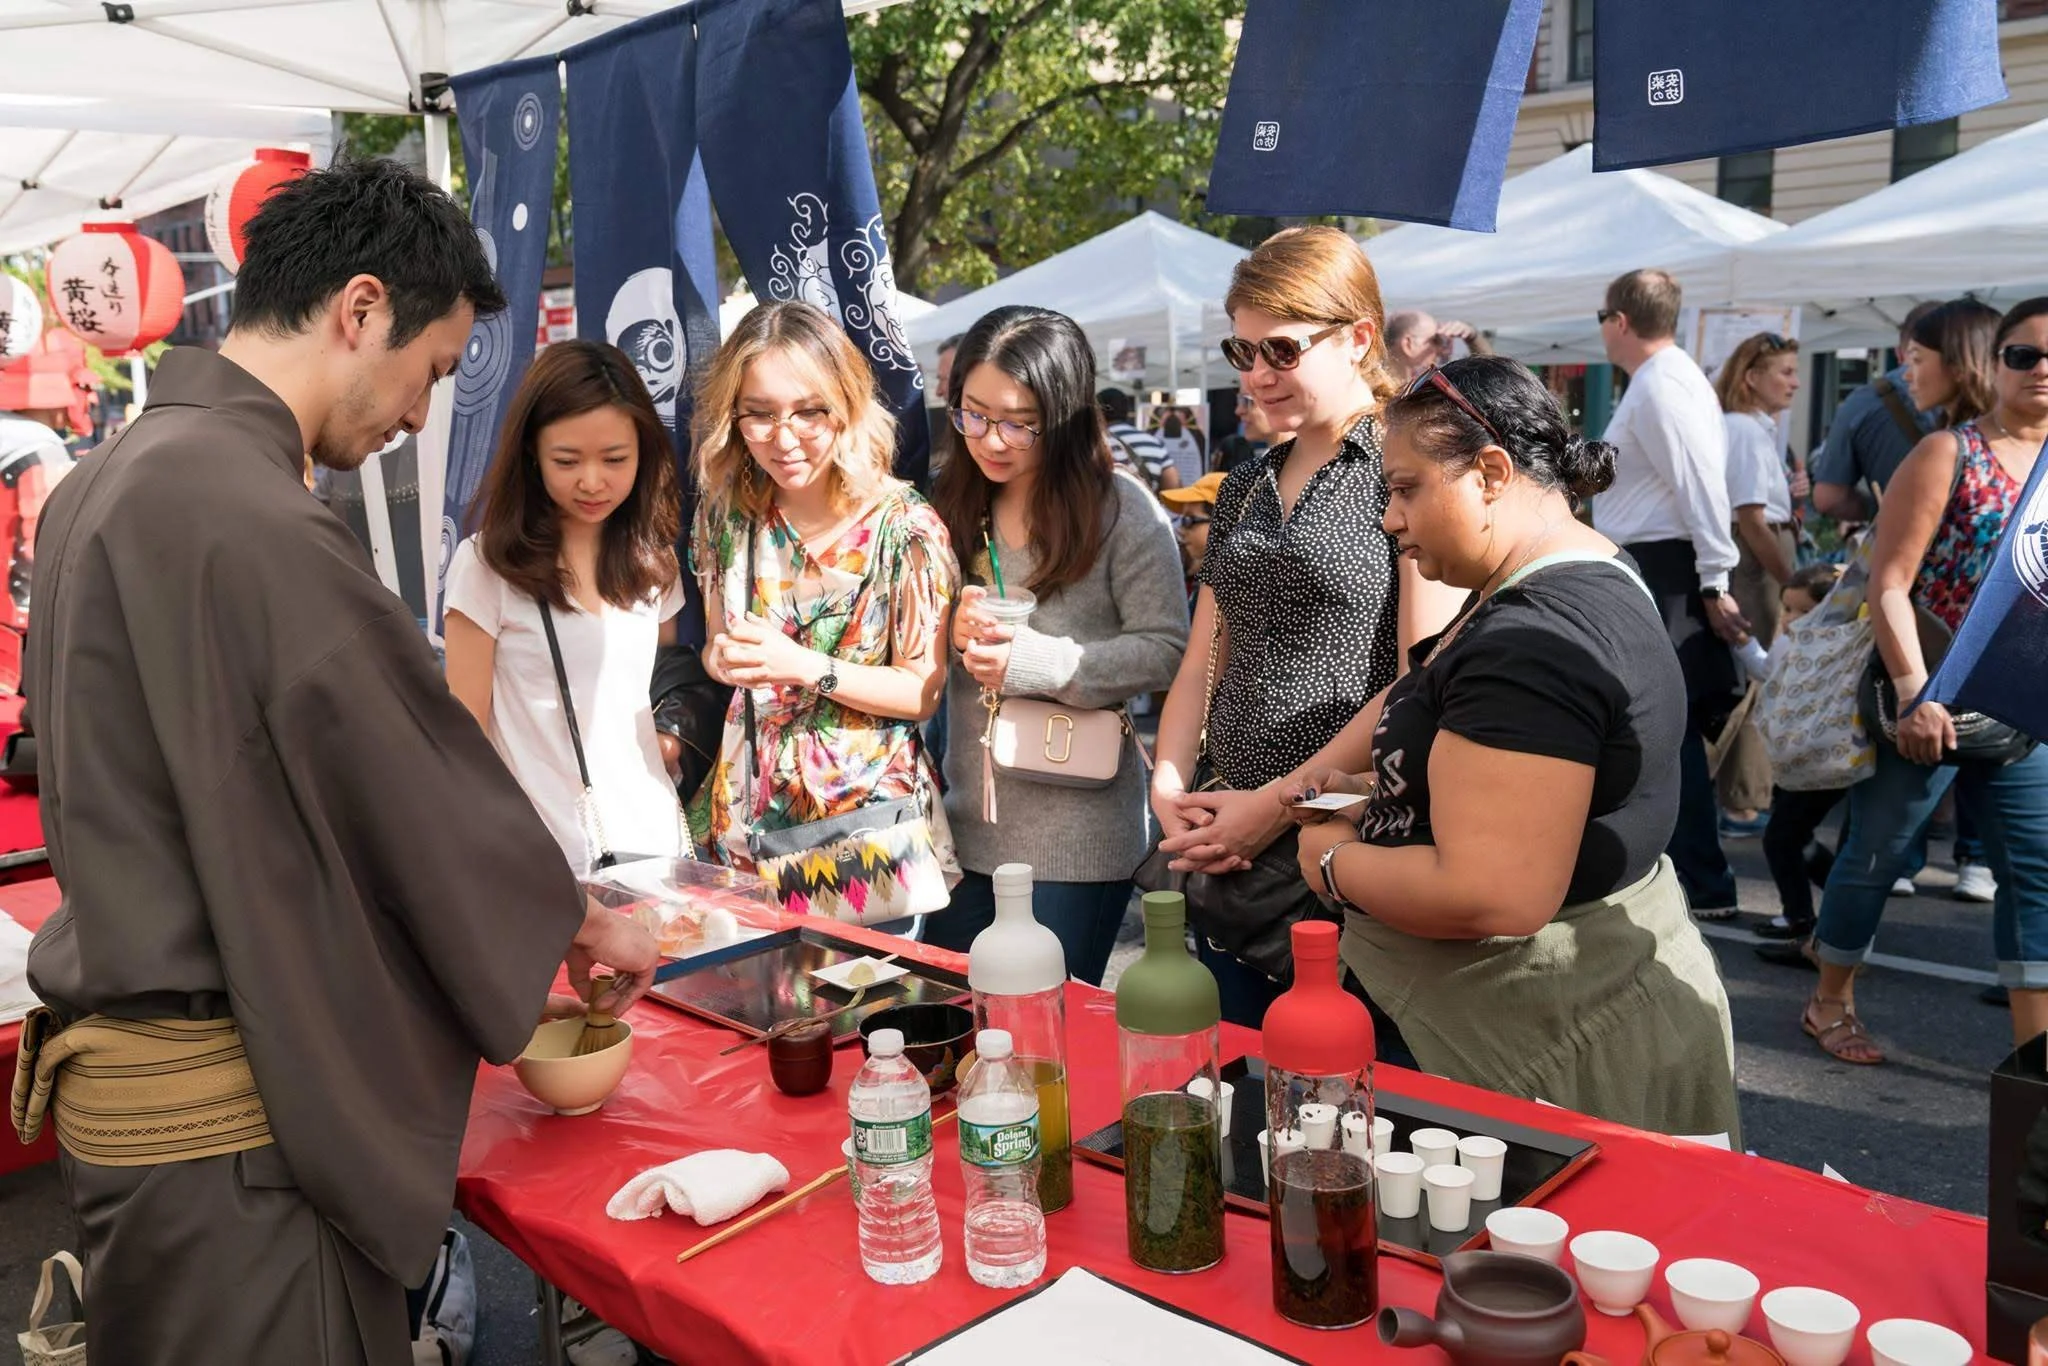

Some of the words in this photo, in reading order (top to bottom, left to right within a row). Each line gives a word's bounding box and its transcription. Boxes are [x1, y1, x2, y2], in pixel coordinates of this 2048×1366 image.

[62, 278, 105, 334] 黄桜
[996, 1127, 1028, 1143] Poland
[993, 1136, 1032, 1158] Spring
